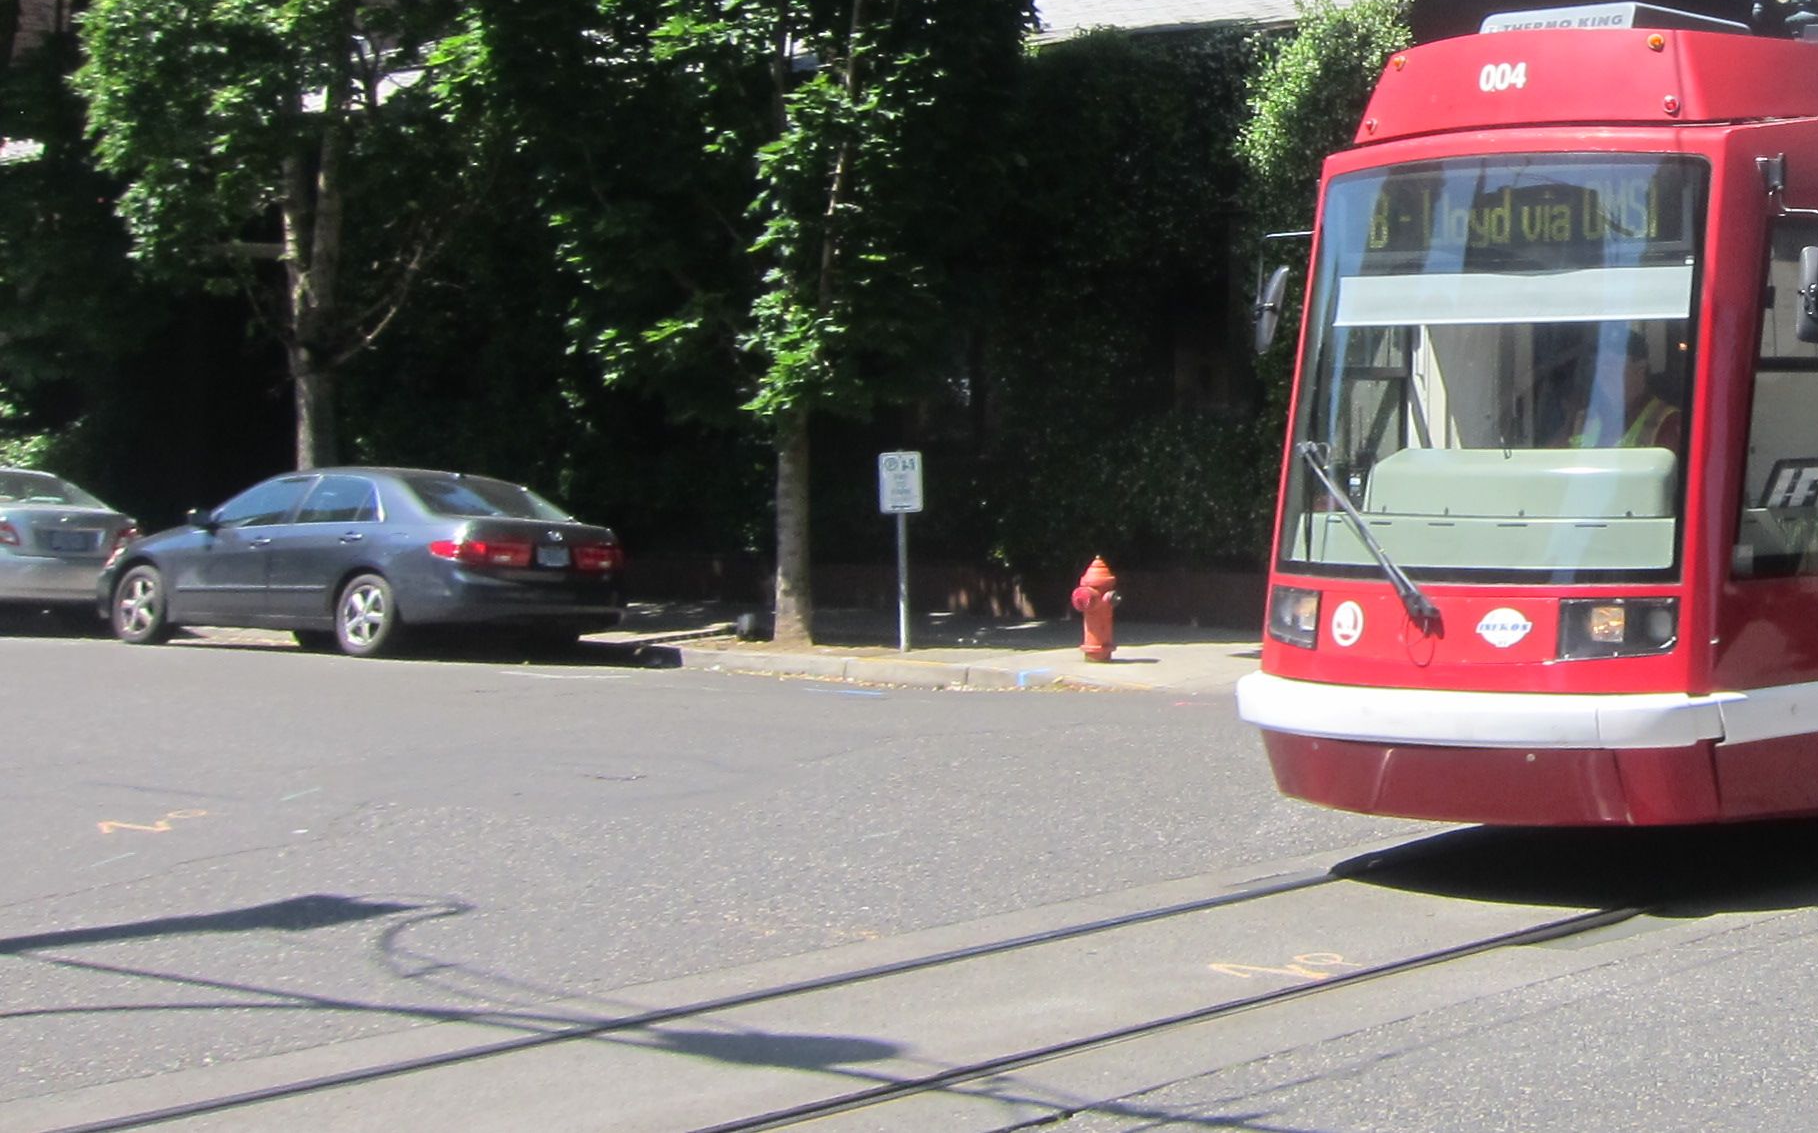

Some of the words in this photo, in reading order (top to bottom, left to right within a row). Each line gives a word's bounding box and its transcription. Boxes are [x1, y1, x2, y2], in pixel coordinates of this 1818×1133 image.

[1503, 19, 1572, 31] THERMO
[1578, 14, 1623, 27] KING
[1479, 62, 1527, 92] 004
[1423, 186, 1511, 248] Lloyd
[1521, 192, 1571, 242] via
